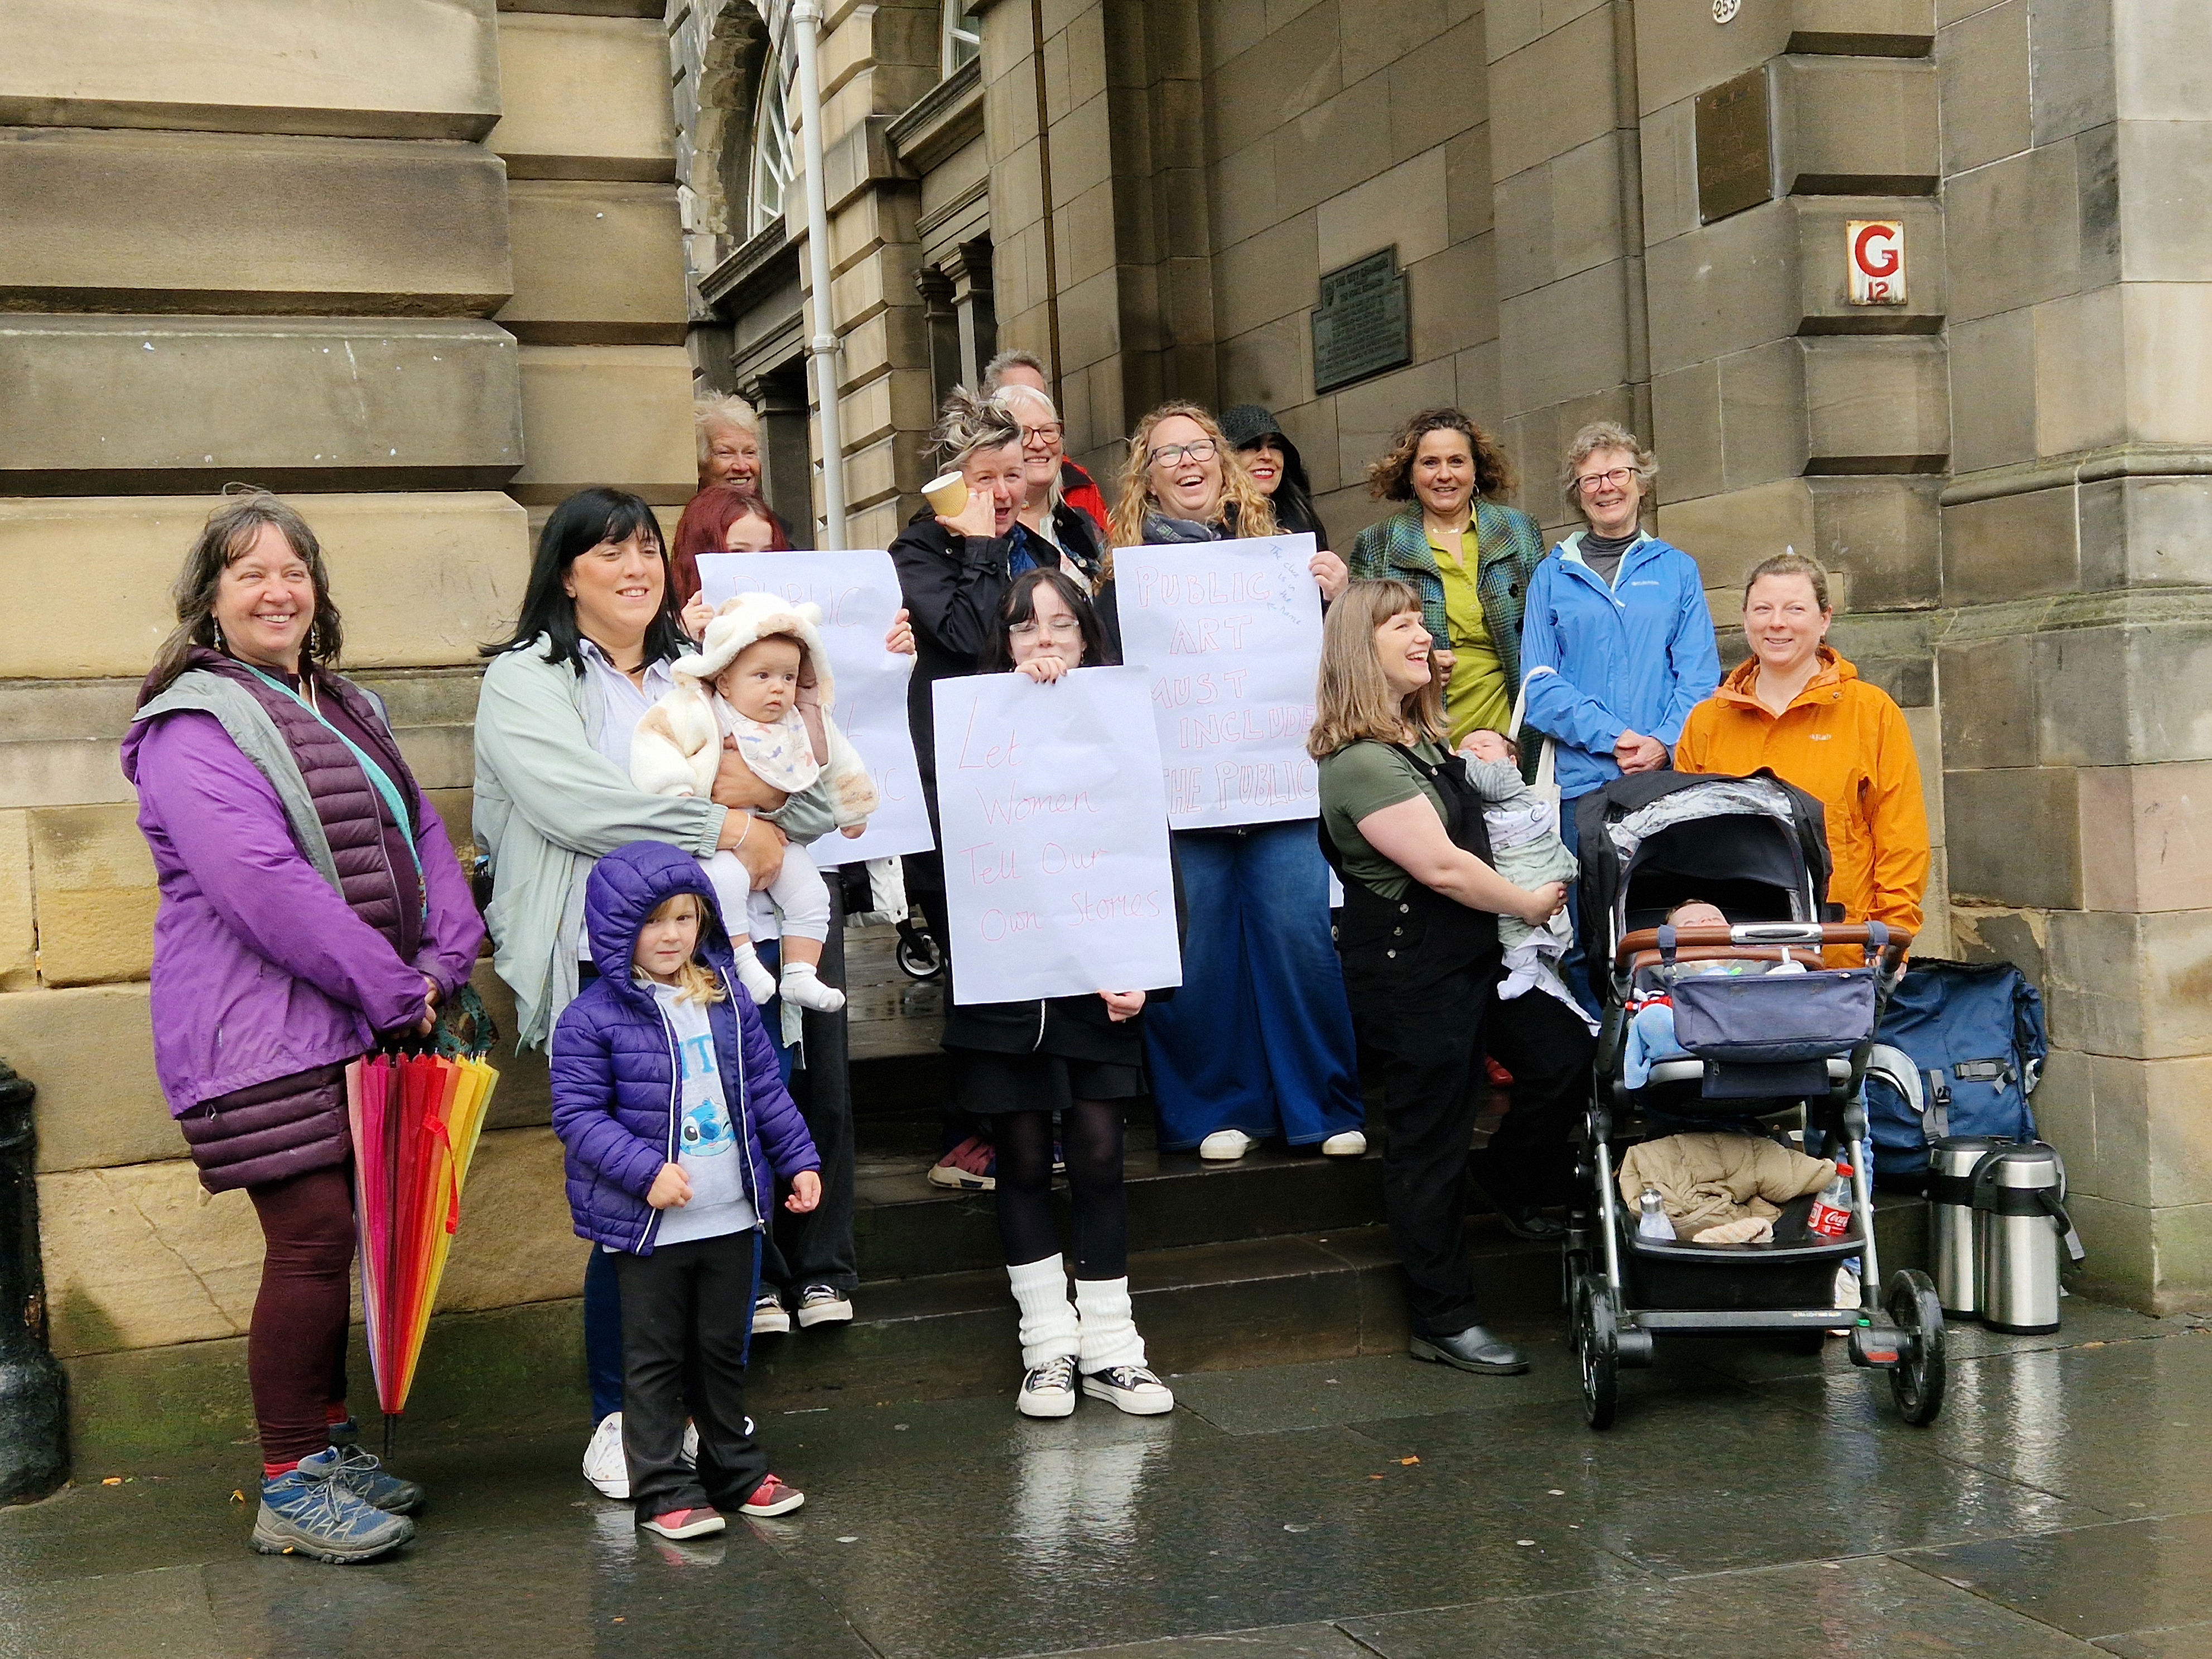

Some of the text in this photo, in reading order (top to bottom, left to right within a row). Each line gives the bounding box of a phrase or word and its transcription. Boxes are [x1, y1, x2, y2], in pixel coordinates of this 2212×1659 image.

[1855, 224, 1900, 278] G
[1867, 281, 1891, 301] 12
[1135, 565, 1270, 607] PUBLIC
[1169, 615, 1252, 655] ART
[958, 696, 1022, 770] Let
[1179, 704, 1315, 749] INCLUDE
[975, 779, 1100, 824] Women
[1215, 759, 1318, 811] PUBLIC
[958, 842, 1109, 885] Tell Our
[981, 909, 1043, 942] Own
